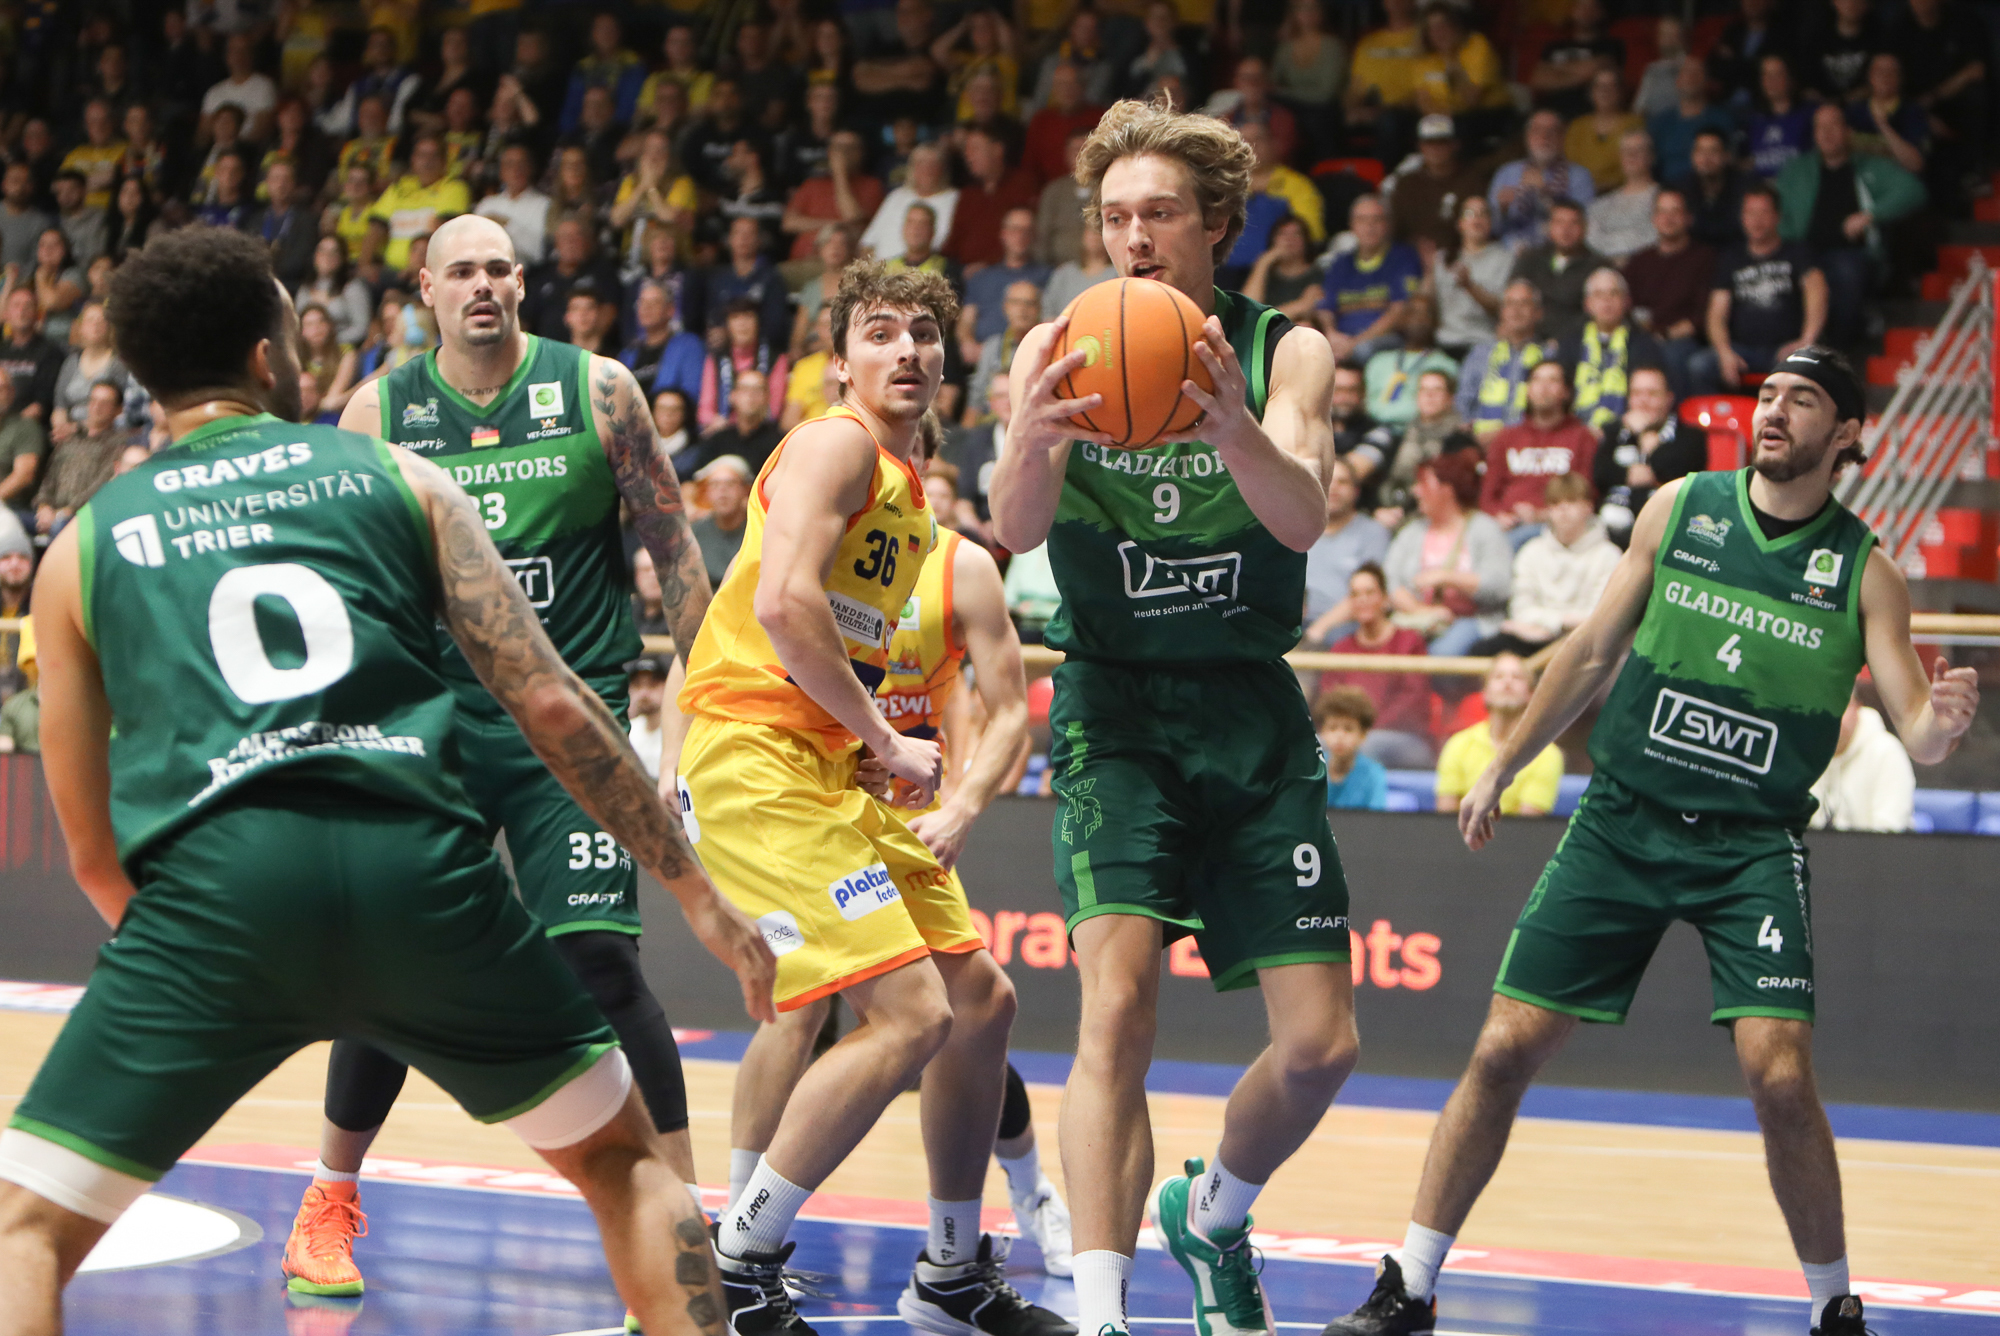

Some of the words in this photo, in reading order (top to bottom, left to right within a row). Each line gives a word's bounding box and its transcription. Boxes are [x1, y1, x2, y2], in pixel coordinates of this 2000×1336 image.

[399, 440, 436, 450] CRAFT
[1082, 442, 1227, 478] GLADIATOR
[153, 442, 313, 493] GRAVES
[440, 455, 567, 486] ADIATORS
[163, 470, 374, 530] UNIVERSITÄT
[1153, 483, 1180, 523] 9
[171, 523, 274, 560] TRIER
[854, 529, 899, 587] 36
[1673, 550, 1709, 568] CRAFT
[1134, 608, 1161, 618] Heute
[1163, 605, 1190, 615] schon
[1192, 602, 1203, 611] an
[1665, 581, 1823, 649] GLADIATORS
[1791, 592, 1837, 610] VET-CONCEPT
[209, 562, 355, 705] 0
[1716, 633, 1742, 673] 4
[1680, 710, 1763, 757] SWT
[1644, 747, 1666, 760] Heute
[1666, 755, 1688, 769] schon
[1689, 762, 1699, 772] an
[1700, 765, 1730, 779] morgen
[569, 831, 617, 870] 33
[1293, 842, 1321, 887] 9
[568, 893, 618, 906] CRAFT
[835, 870, 891, 909] platzm
[1296, 916, 1347, 930] CRAFT
[1757, 915, 1783, 953] 4
[1757, 976, 1807, 990] CRAFT
[749, 1188, 770, 1222] CRAFT
[943, 1216, 955, 1247] CRAFT
